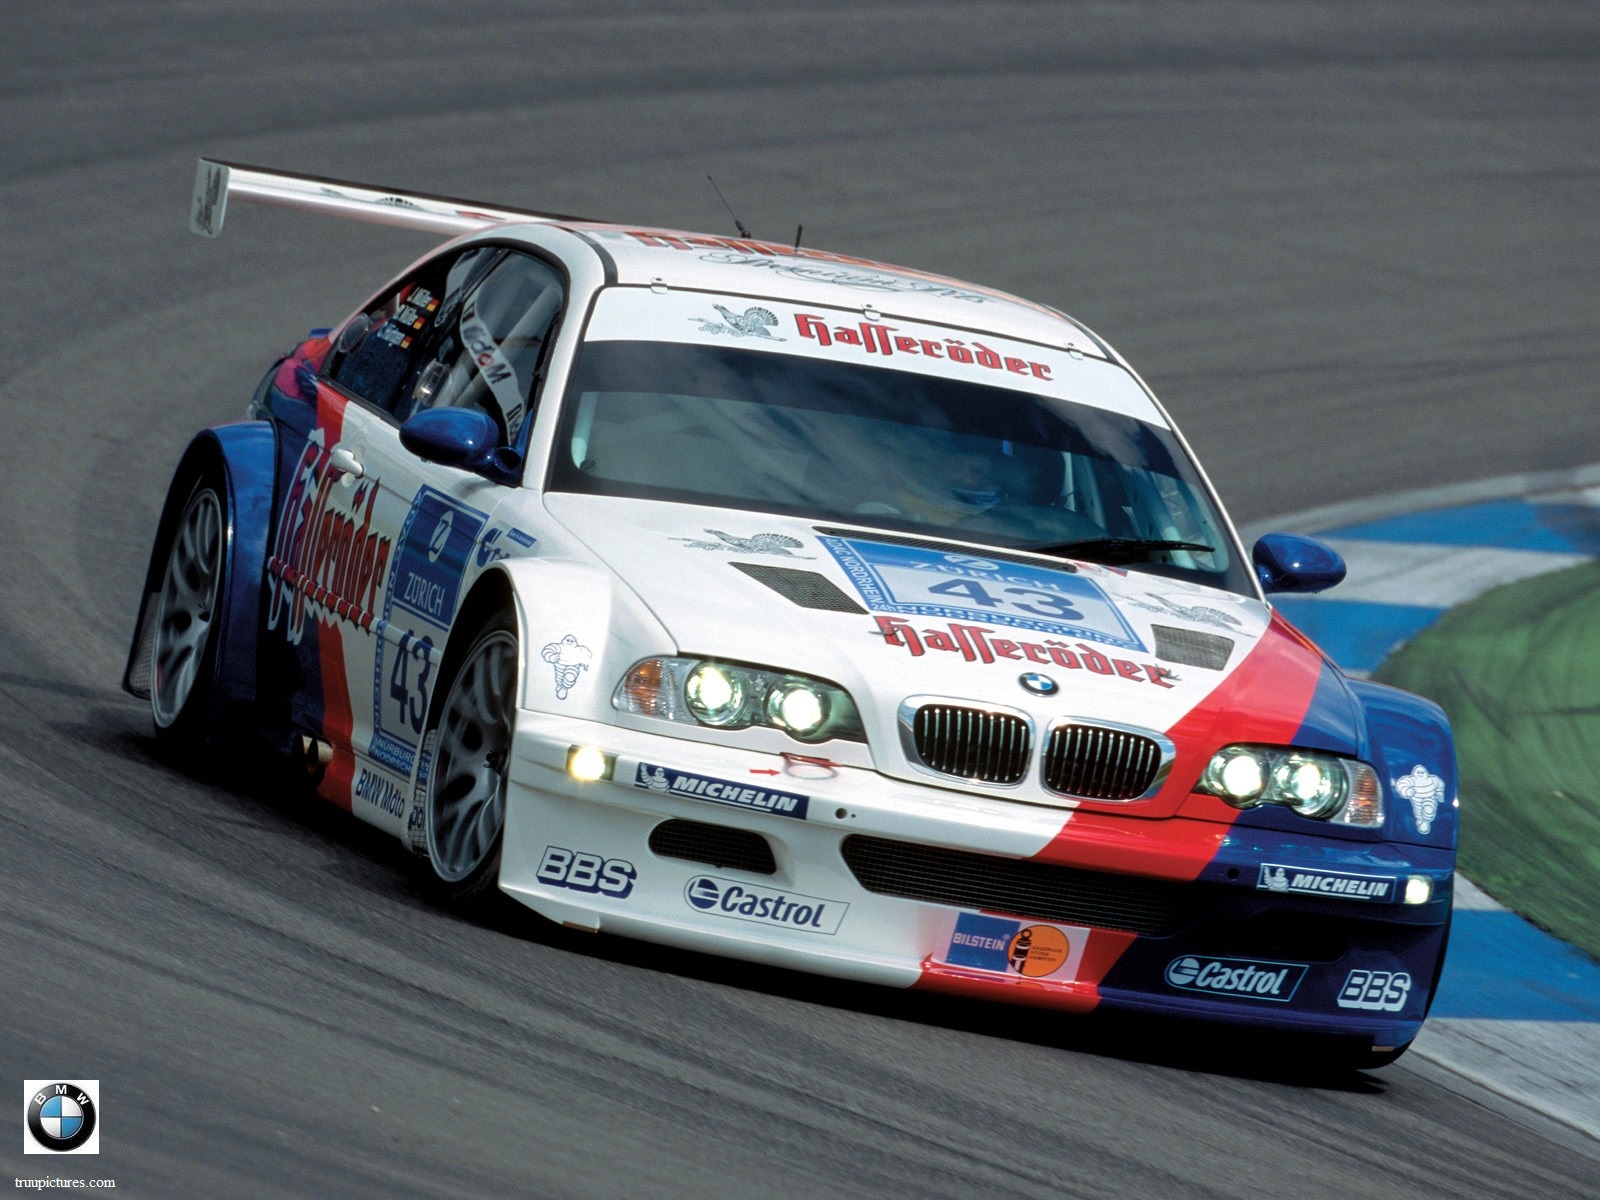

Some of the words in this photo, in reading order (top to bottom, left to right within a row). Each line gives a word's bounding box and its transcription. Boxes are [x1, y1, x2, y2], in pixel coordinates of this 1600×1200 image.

[794, 313, 1054, 381] Hasseröder
[404, 571, 446, 618] ZÜRICH
[909, 561, 1061, 591] ZÜRICH
[871, 603, 898, 614] 24h
[927, 578, 1085, 621] 43
[872, 615, 1176, 689] Hasseröder
[390, 629, 434, 735] 43
[671, 775, 799, 812] MICHELIN
[536, 845, 638, 900] BBS
[1290, 873, 1389, 897] MICHELIN
[719, 885, 826, 928] Castrol
[952, 932, 1006, 951] BILSTEIN
[1195, 961, 1289, 995] Castrol
[1337, 969, 1412, 1012] BBS
